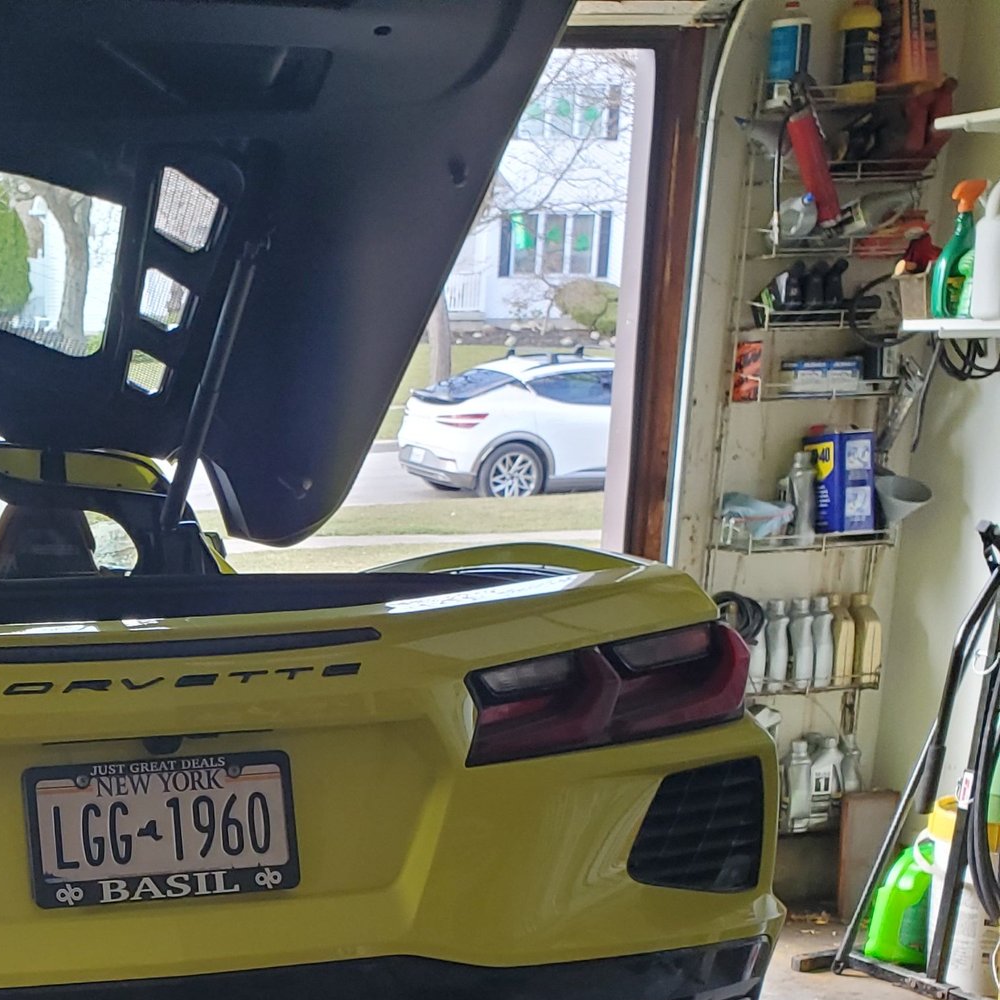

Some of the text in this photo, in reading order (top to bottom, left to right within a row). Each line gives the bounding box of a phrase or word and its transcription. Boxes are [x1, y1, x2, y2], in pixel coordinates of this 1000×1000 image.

[90, 756, 226, 776] JUST GREAT DEALS
[96, 768, 225, 798] NEW YORK
[52, 791, 271, 870] LGG 1960
[98, 870, 241, 904] BASIL
